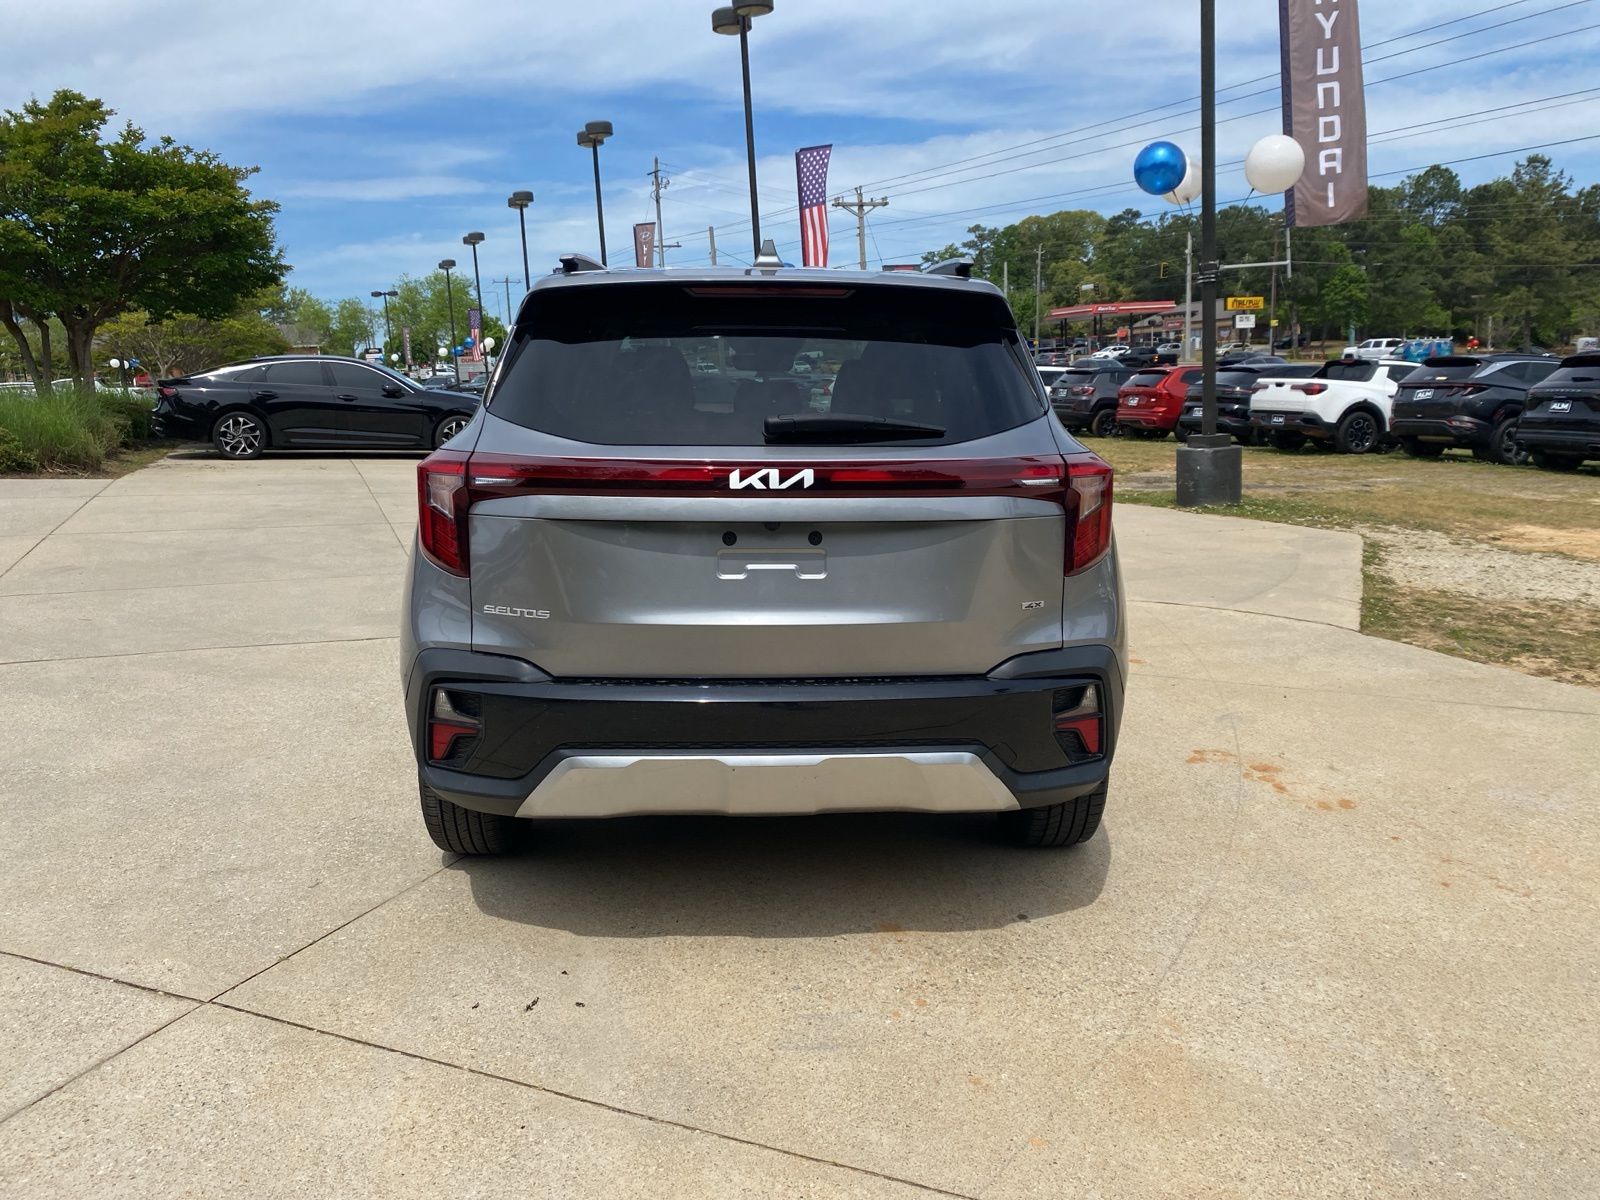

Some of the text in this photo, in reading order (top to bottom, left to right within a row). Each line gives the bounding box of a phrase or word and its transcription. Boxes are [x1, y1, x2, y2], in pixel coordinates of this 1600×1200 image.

[1315, 0, 1342, 208] YUNDAI
[1550, 402, 1570, 410] ALM
[729, 468, 815, 490] KIA
[483, 604, 551, 619] SELTOS
